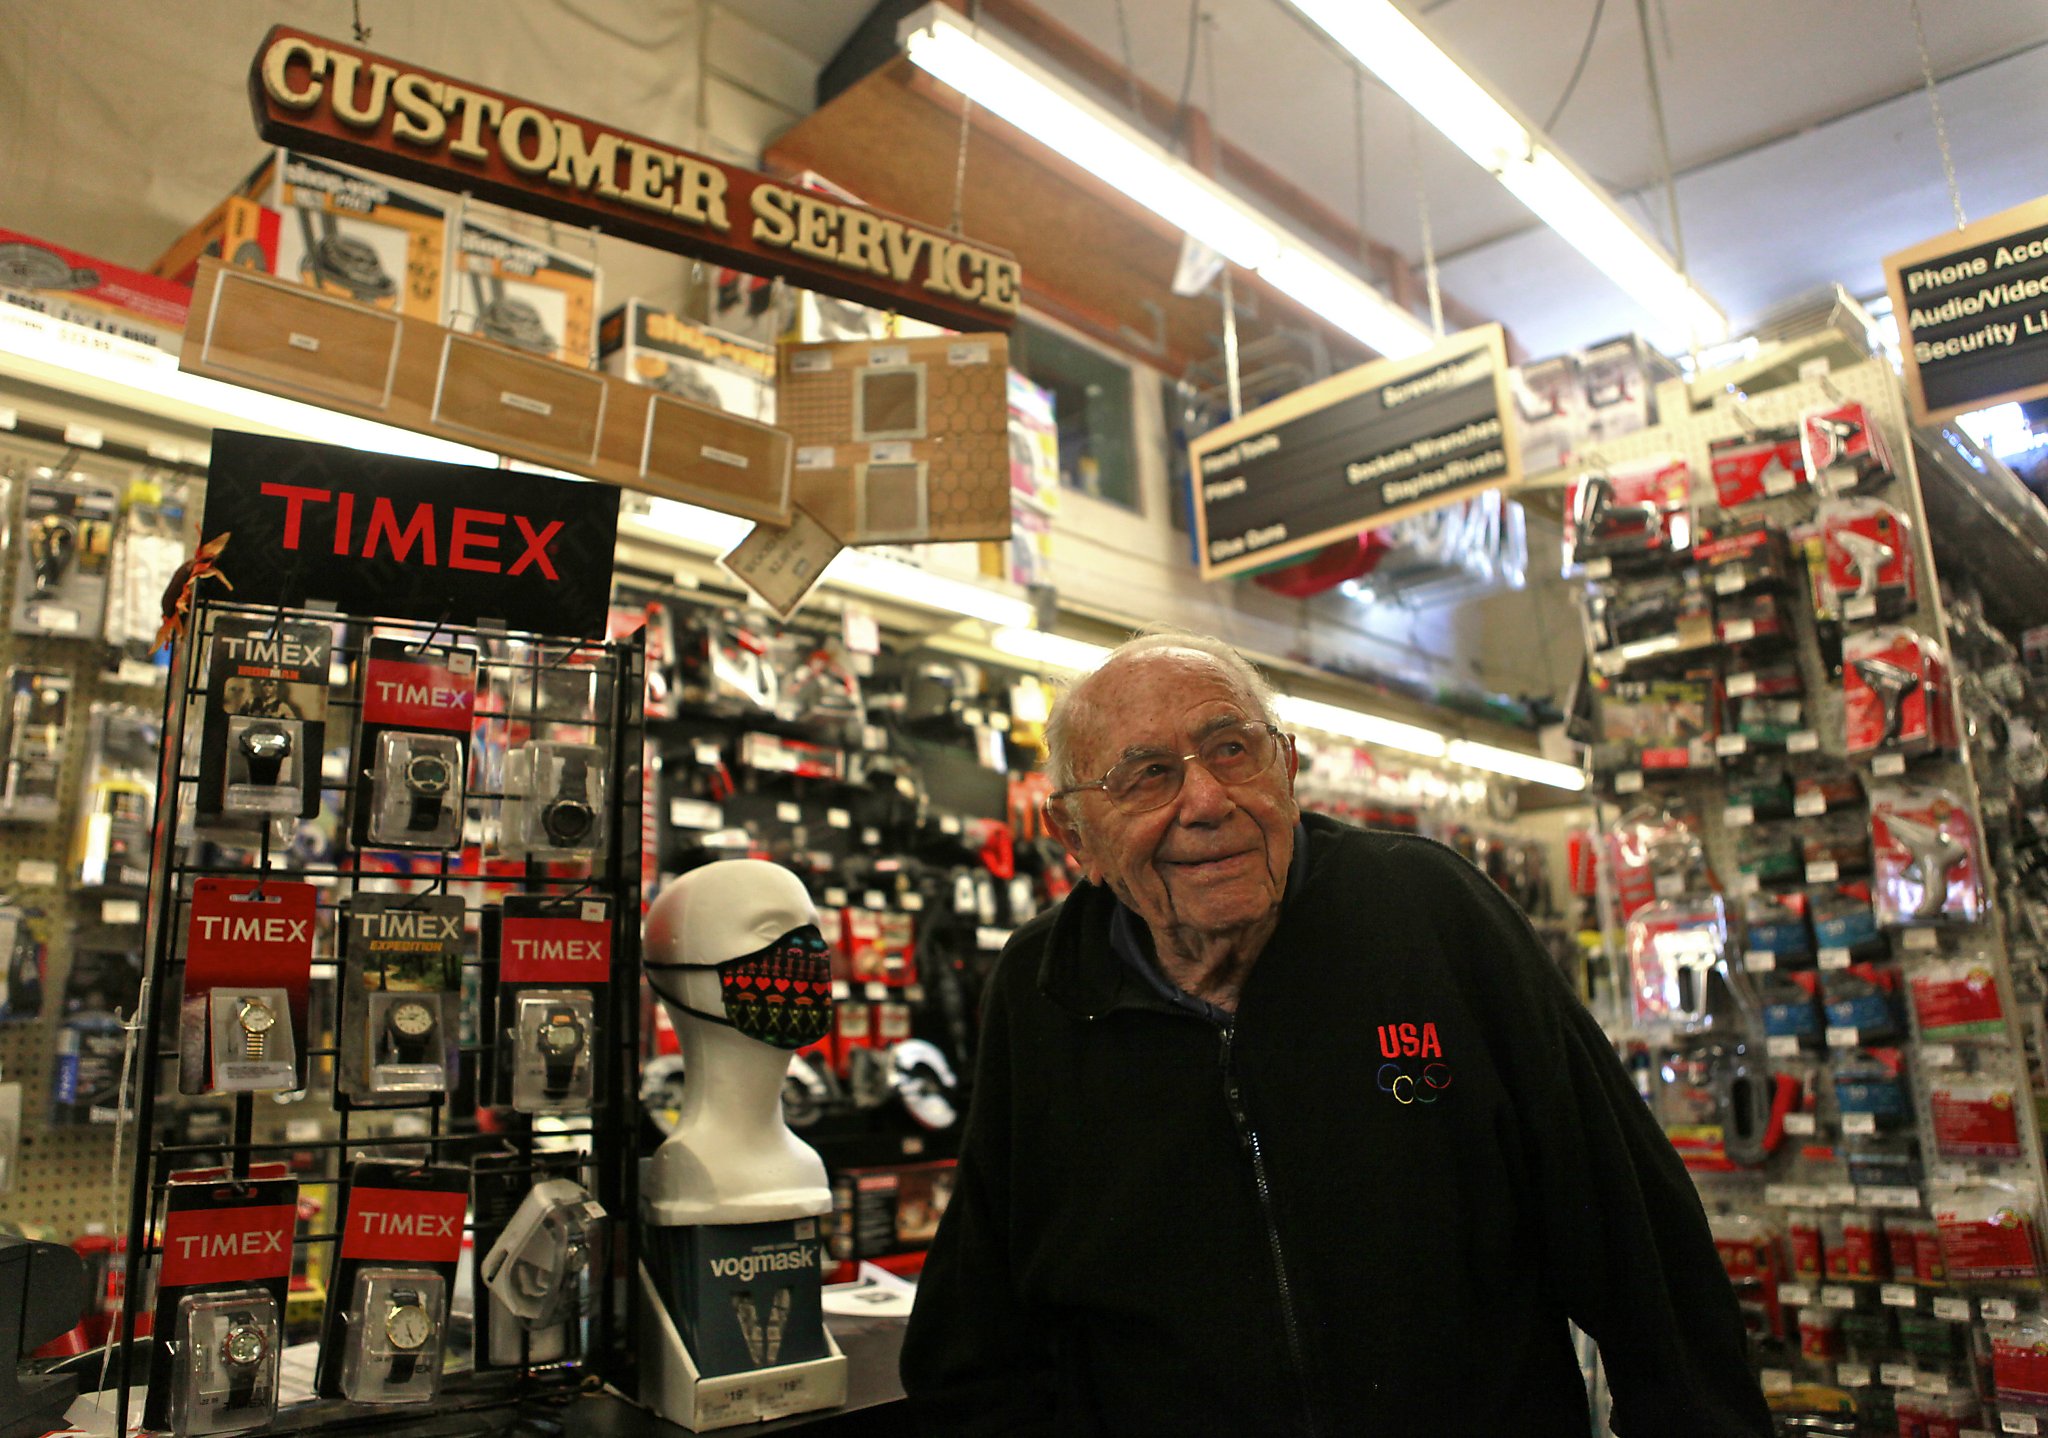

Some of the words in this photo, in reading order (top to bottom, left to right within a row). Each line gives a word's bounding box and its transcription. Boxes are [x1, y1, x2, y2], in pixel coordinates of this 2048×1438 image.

[262, 36, 729, 230] CUSTOMER
[751, 182, 1021, 307] SERVICE
[1907, 256, 1989, 294] Phone
[1913, 320, 2018, 364] Security
[260, 482, 565, 581] TIMEX
[221, 636, 322, 668] TIMEX
[375, 680, 467, 710] TIMEX
[196, 915, 308, 943] TIMEX
[354, 912, 460, 940] TIMEX
[511, 939, 603, 960] TIMEX
[1377, 1022, 1443, 1059] USA
[358, 1211, 457, 1238] TIMEX
[175, 1229, 283, 1260] TIMEX
[710, 1244, 815, 1282] vogmask
